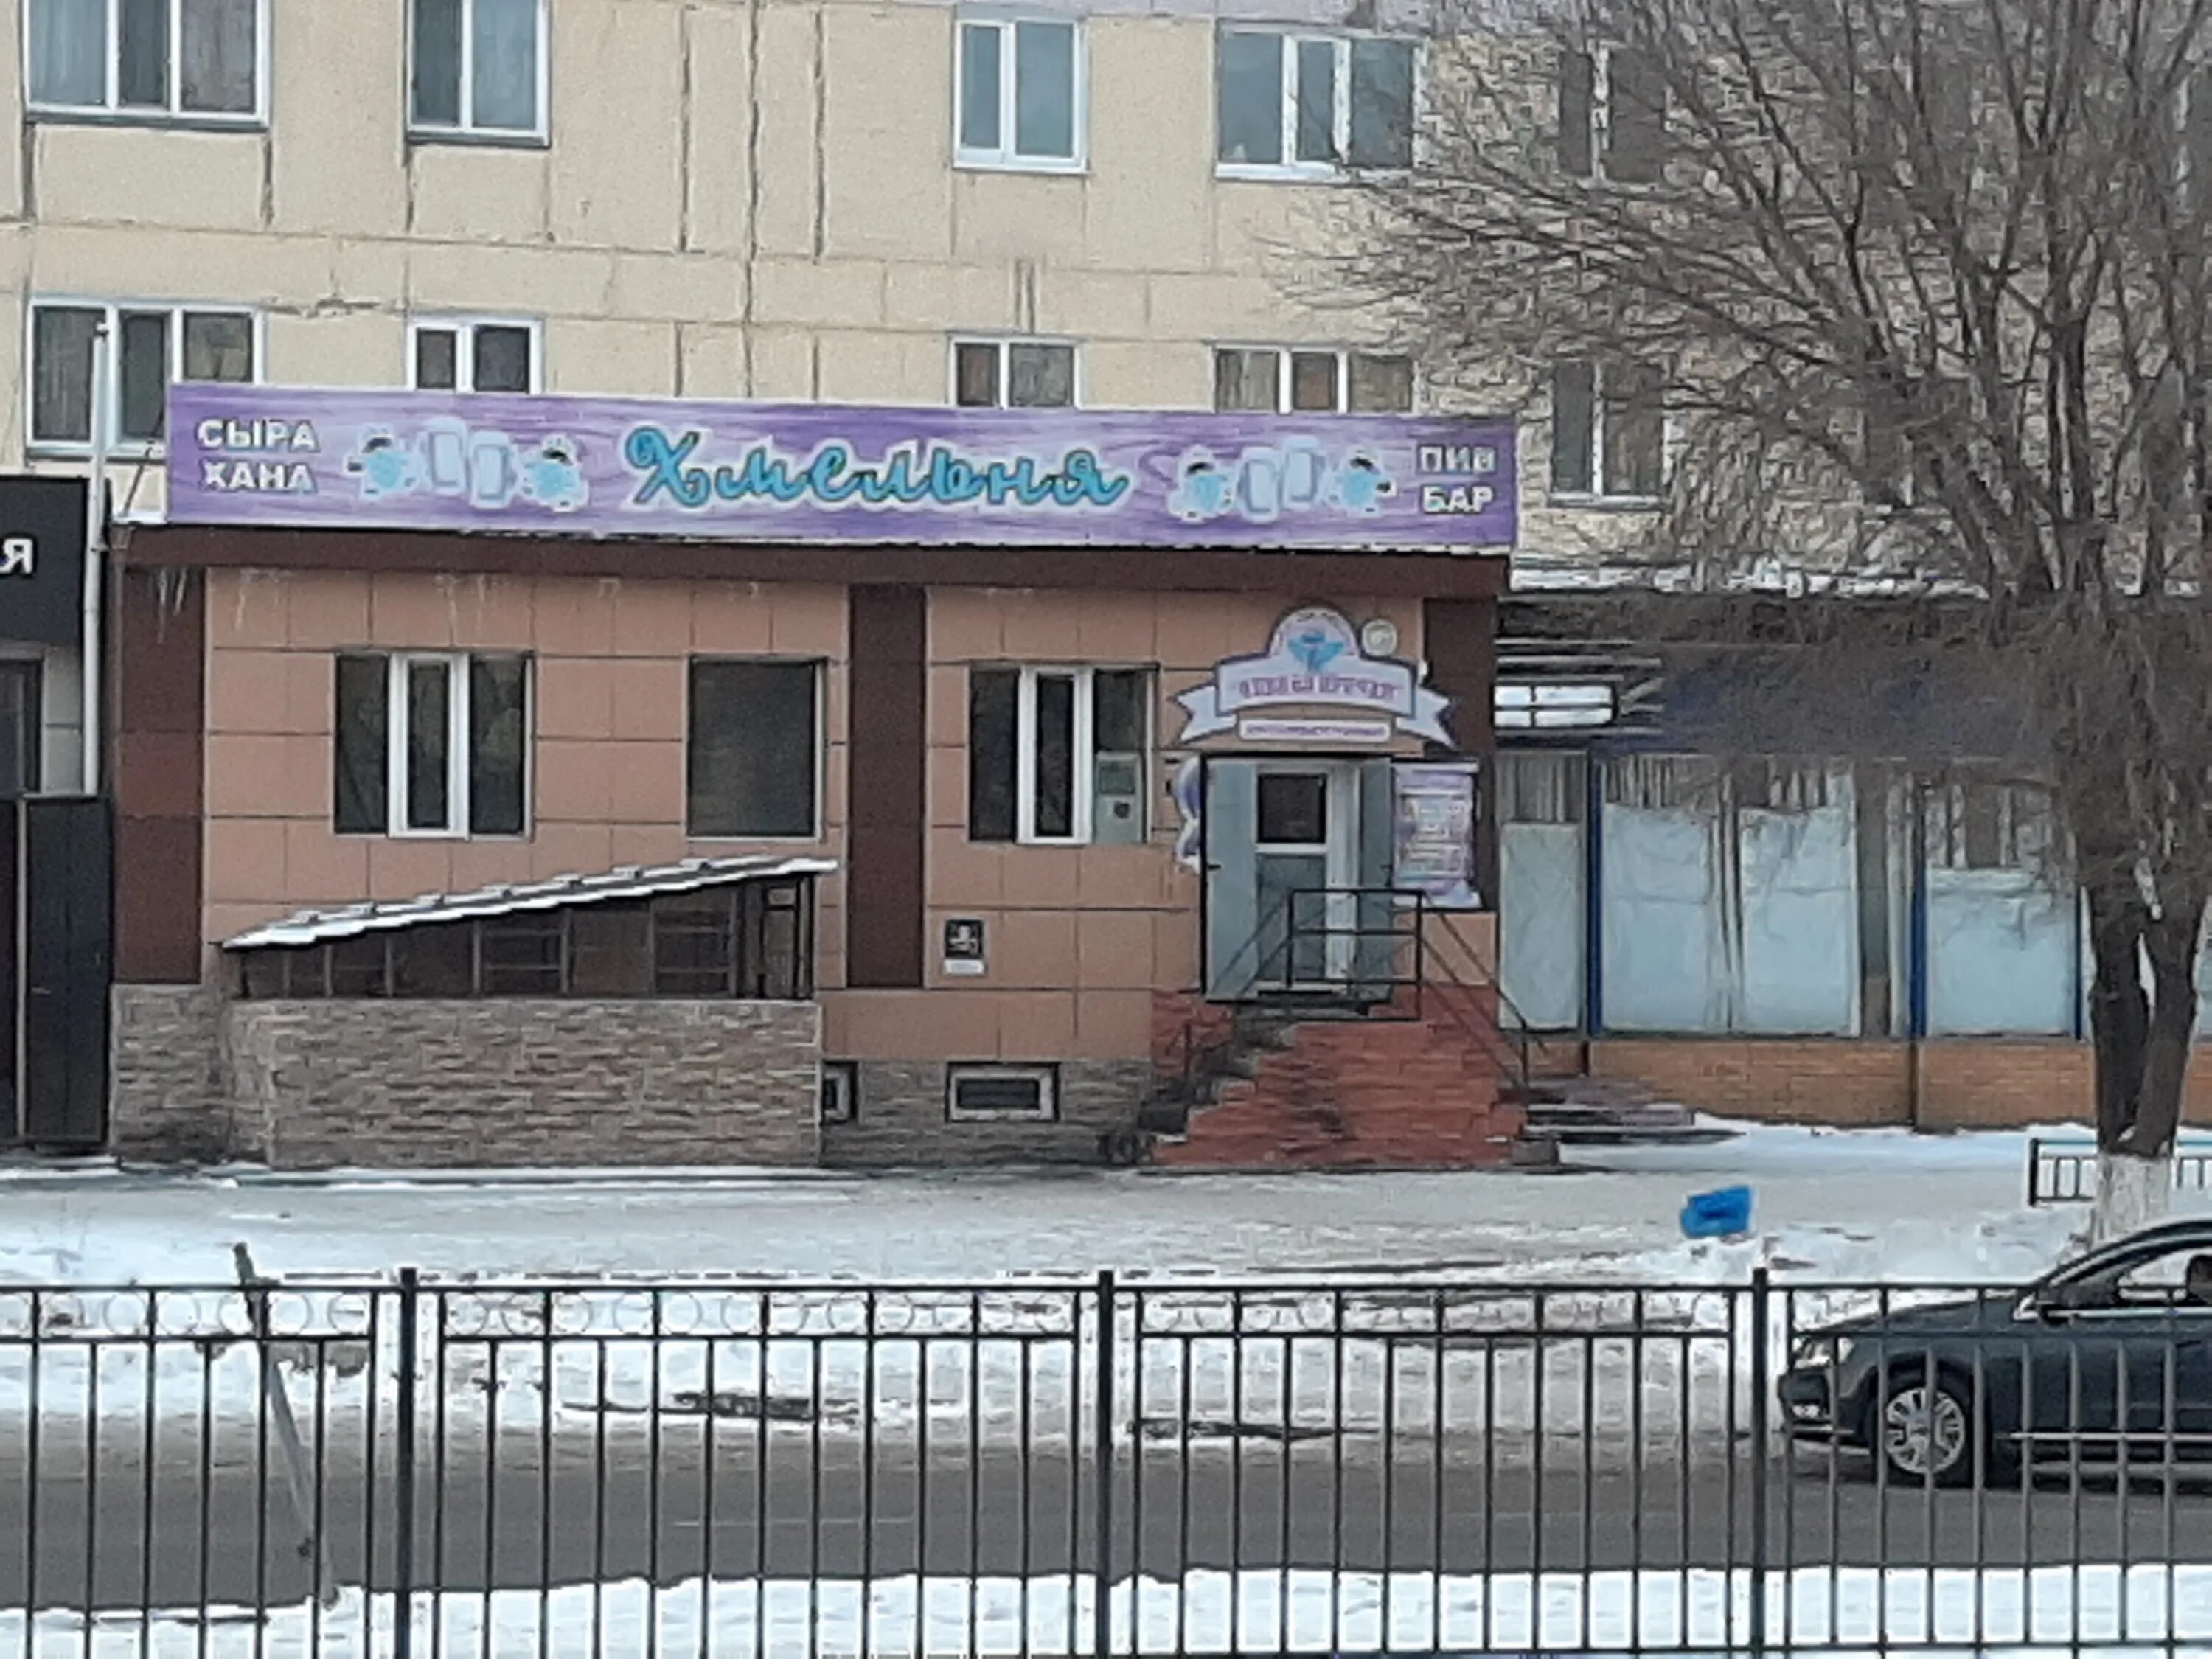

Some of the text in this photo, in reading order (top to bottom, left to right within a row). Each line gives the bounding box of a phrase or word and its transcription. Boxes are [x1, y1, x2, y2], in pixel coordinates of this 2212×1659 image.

[197, 419, 316, 451] СЫРА
[203, 459, 314, 490] ХАНА
[1423, 485, 1494, 512] БАР
